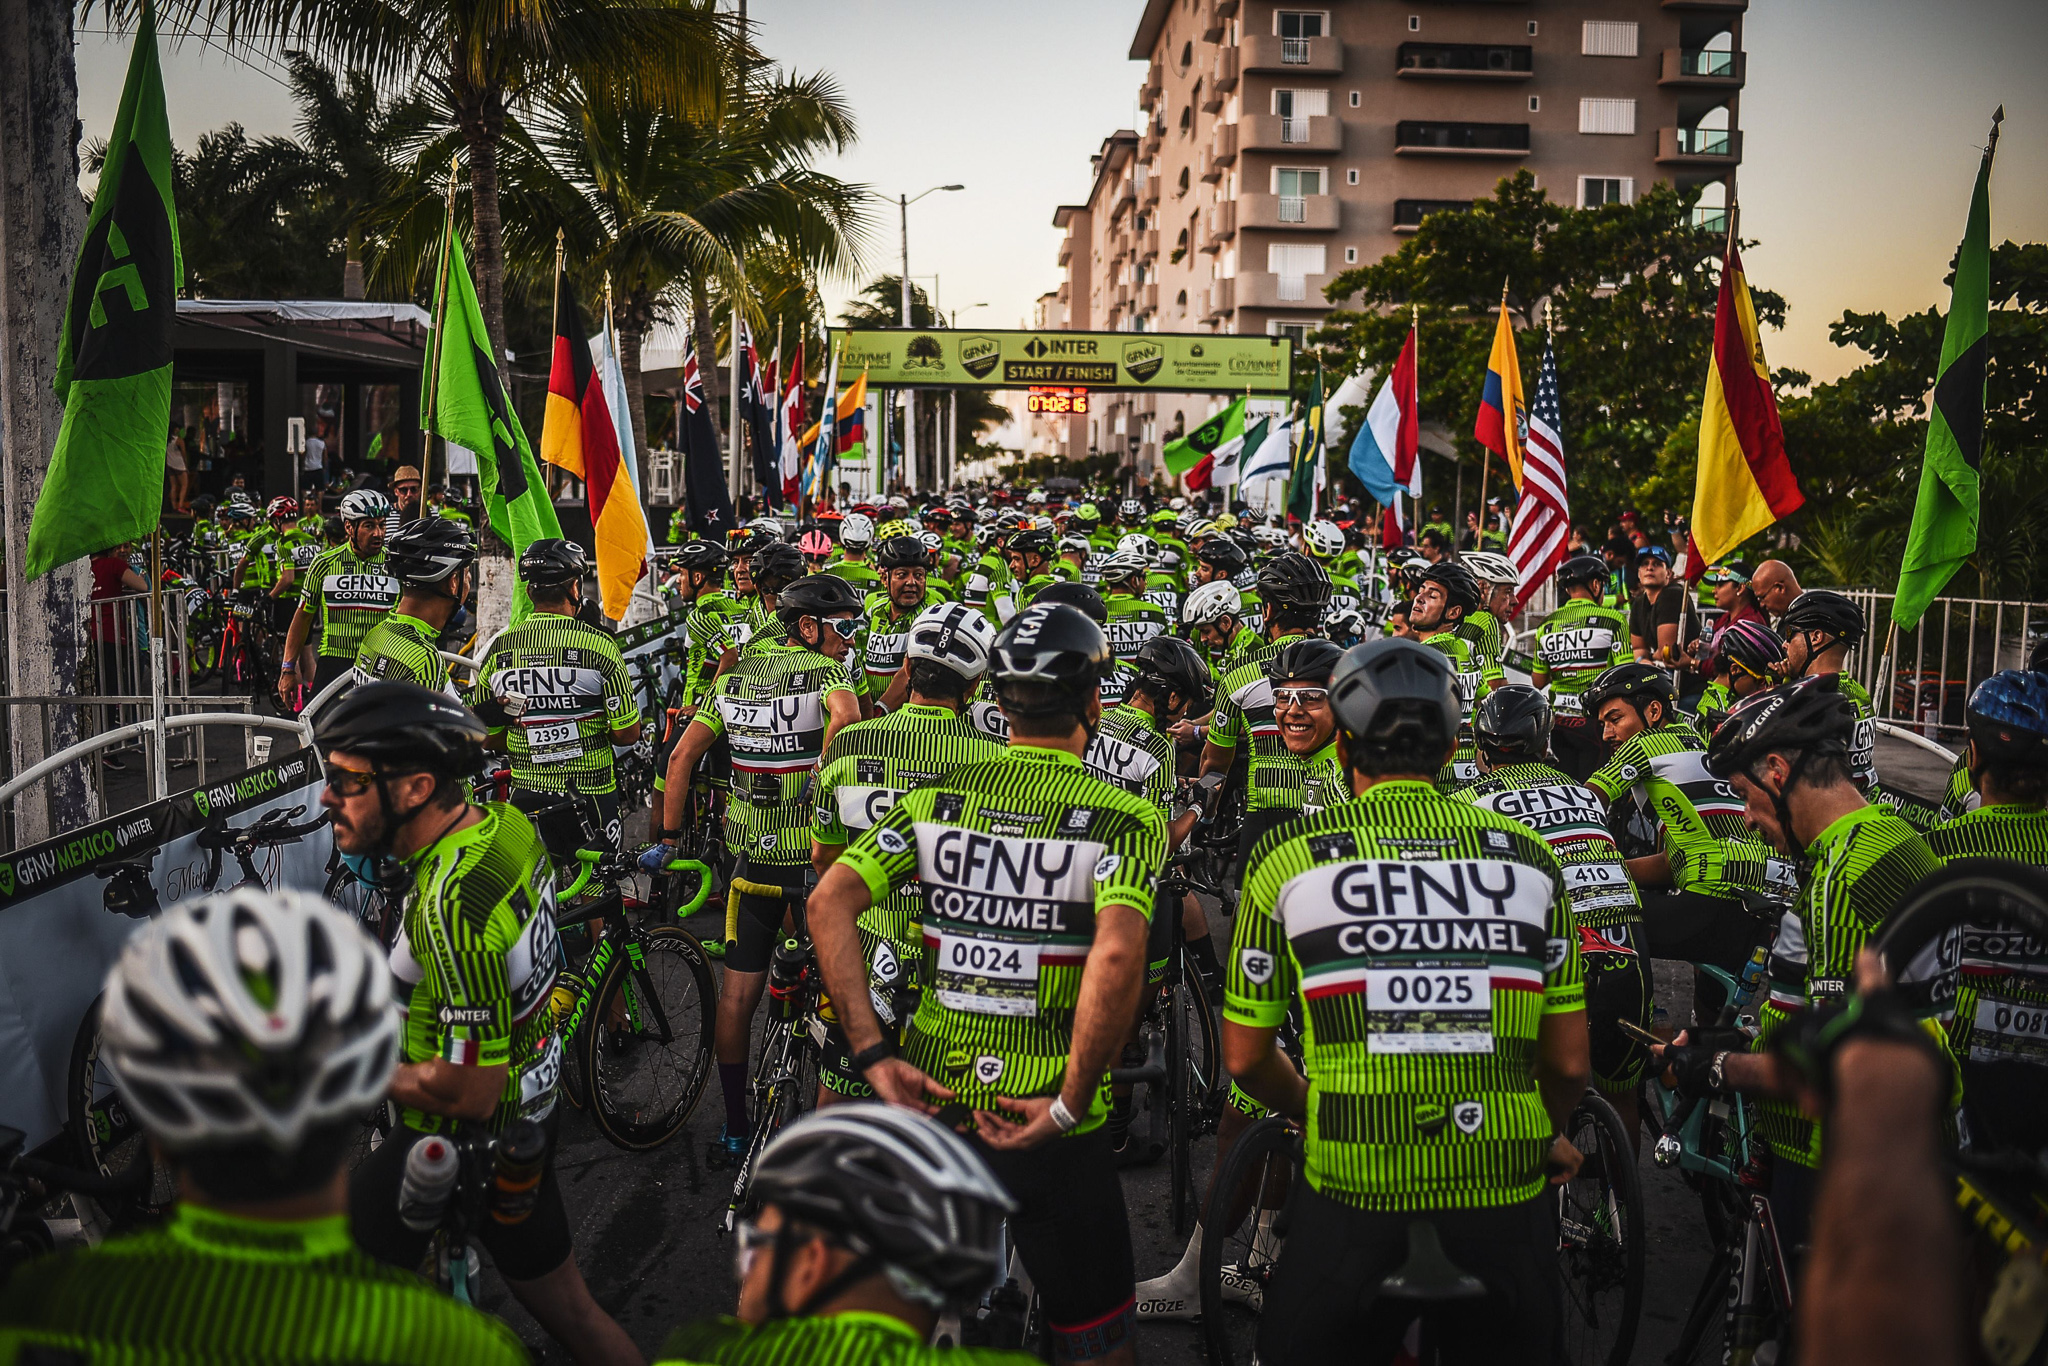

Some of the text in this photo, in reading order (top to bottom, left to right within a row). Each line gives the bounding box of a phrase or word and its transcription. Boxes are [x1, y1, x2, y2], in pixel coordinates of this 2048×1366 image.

[1050, 340, 1098, 355] INTER
[1008, 365, 1052, 380] START
[1066, 367, 1113, 381] FINISH
[1028, 395, 1087, 412] 07:02:16
[336, 576, 389, 591] GFNY
[334, 591, 389, 602] COZUMEL
[869, 635, 898, 652] GFNY
[1545, 630, 1594, 652] GFNY
[1548, 650, 1594, 663] COZUMEL
[502, 668, 577, 696] GFNY
[1641, 674, 1658, 683] MEXICO
[527, 696, 582, 710] ZUMEL
[1562, 696, 1576, 706] 316
[732, 707, 758, 724] 797
[907, 707, 943, 717] COZUMEL
[534, 726, 570, 743] 2399
[1010, 749, 1061, 763] COZUMEL
[286, 760, 306, 777] INTER
[857, 765, 885, 773] ULTRA
[208, 769, 278, 809] GFNY MEXICO
[1372, 785, 1432, 797] COZUMEL
[1492, 785, 1597, 816] GFNY
[817, 811, 830, 822] GF
[978, 808, 1044, 823] BONTRAGER
[1518, 809, 1606, 829] OZUMEL
[1661, 796, 1697, 833] GFNY
[127, 817, 153, 837] INTER
[1002, 825, 1024, 835] INTER
[882, 834, 903, 849] GF
[1309, 838, 1354, 851] ULTRA
[1378, 837, 1458, 847] BONTRAGER
[1563, 843, 1589, 853] INTER
[16, 830, 116, 886] GFNY MEXICO
[1411, 850, 1439, 859] INTER
[934, 830, 1075, 897] GFNY
[1098, 858, 1114, 875] GF
[1574, 867, 1610, 882] 410
[1332, 863, 1516, 917] GFNY
[931, 889, 1067, 931] COZUMEL
[1338, 922, 1528, 954] COZUMEL
[952, 942, 1022, 974] 0024
[1246, 957, 1270, 976] GF
[1387, 975, 1473, 1004] 0025
[1814, 980, 1844, 992] INTER
[454, 1009, 491, 1021] INTER
[979, 1062, 999, 1077] GF
[1458, 1107, 1479, 1126] GF
